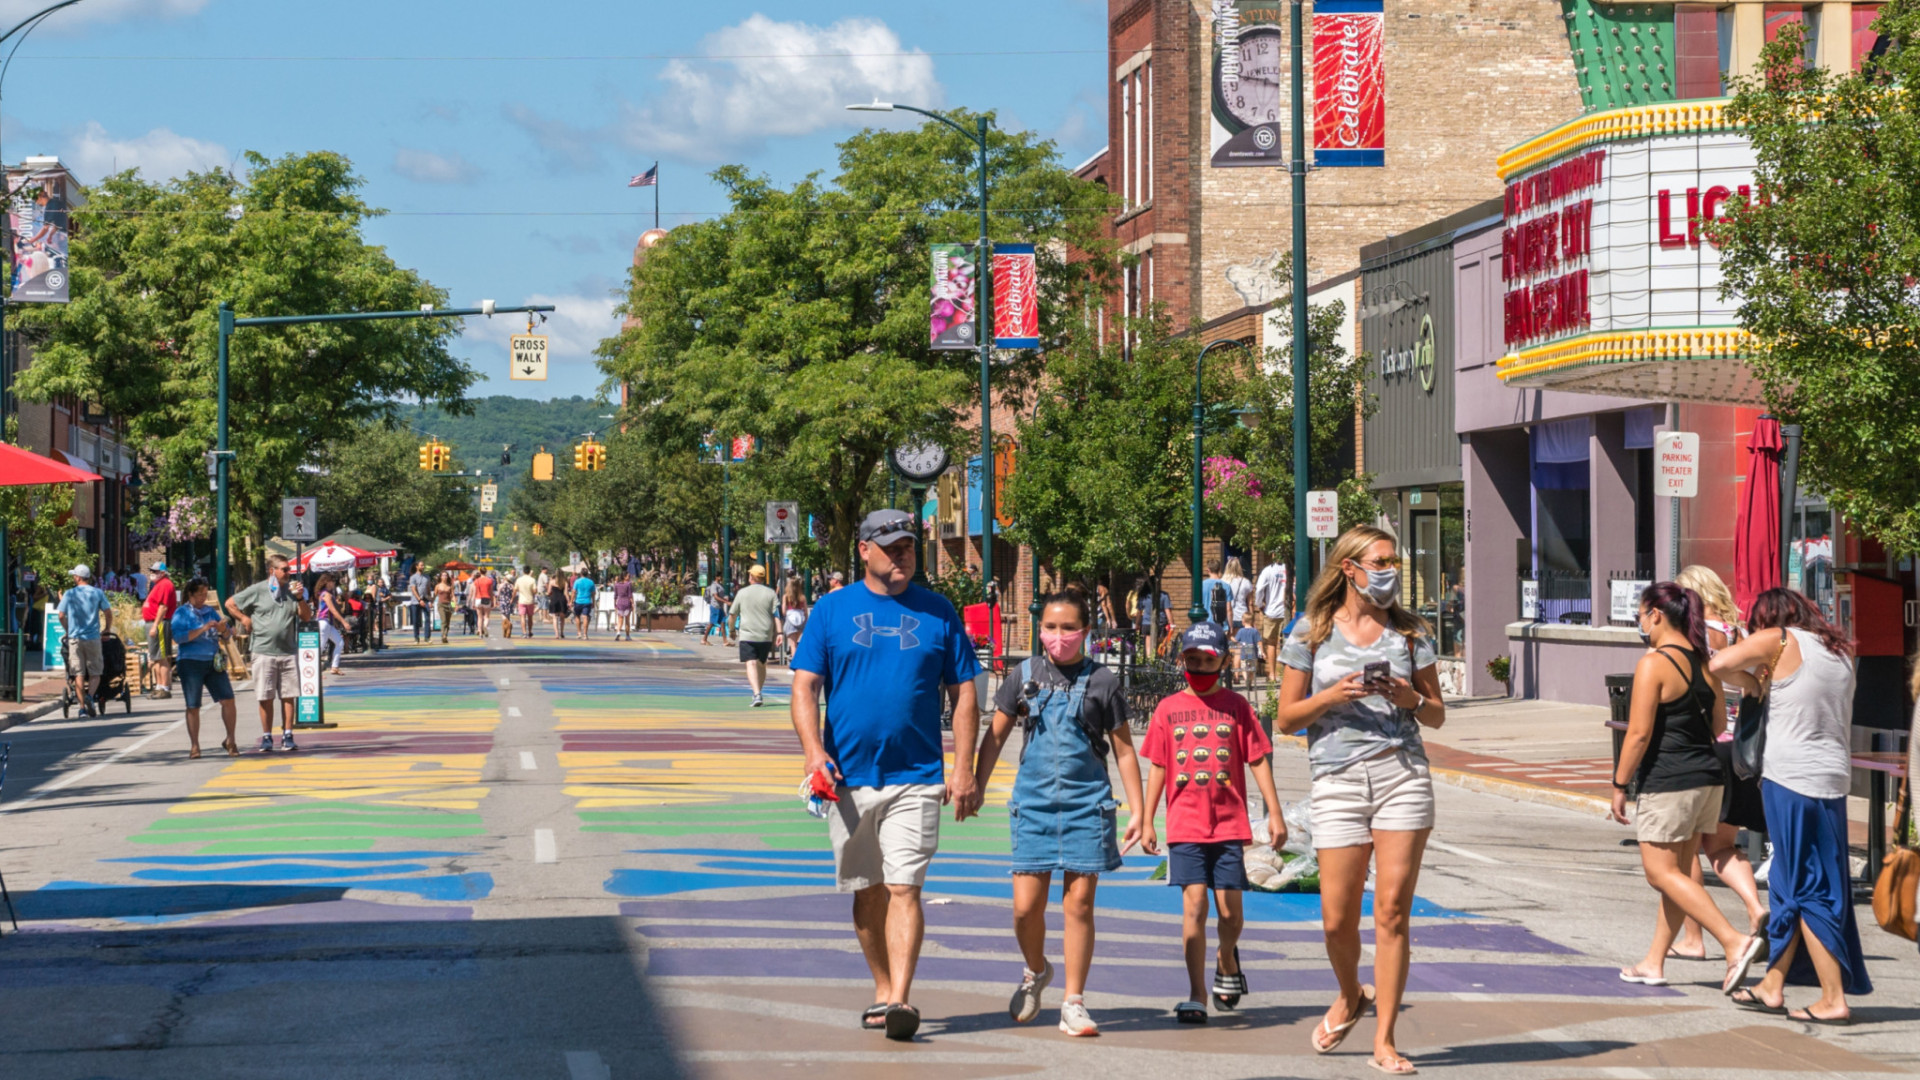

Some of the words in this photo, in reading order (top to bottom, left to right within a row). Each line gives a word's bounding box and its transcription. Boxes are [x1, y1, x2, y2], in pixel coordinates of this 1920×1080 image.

[1221, 8, 1239, 83] DOWNTOWN
[1338, 16, 1360, 147] Celebrate!
[1007, 256, 1022, 336] Celebrate!
[513, 340, 545, 350] CROSS
[516, 352, 542, 363] WALK
[1672, 441, 1683, 450] NO
[1662, 453, 1692, 462] PARKING
[1662, 466, 1692, 475] THEATER
[1668, 479, 1684, 488] EXIT
